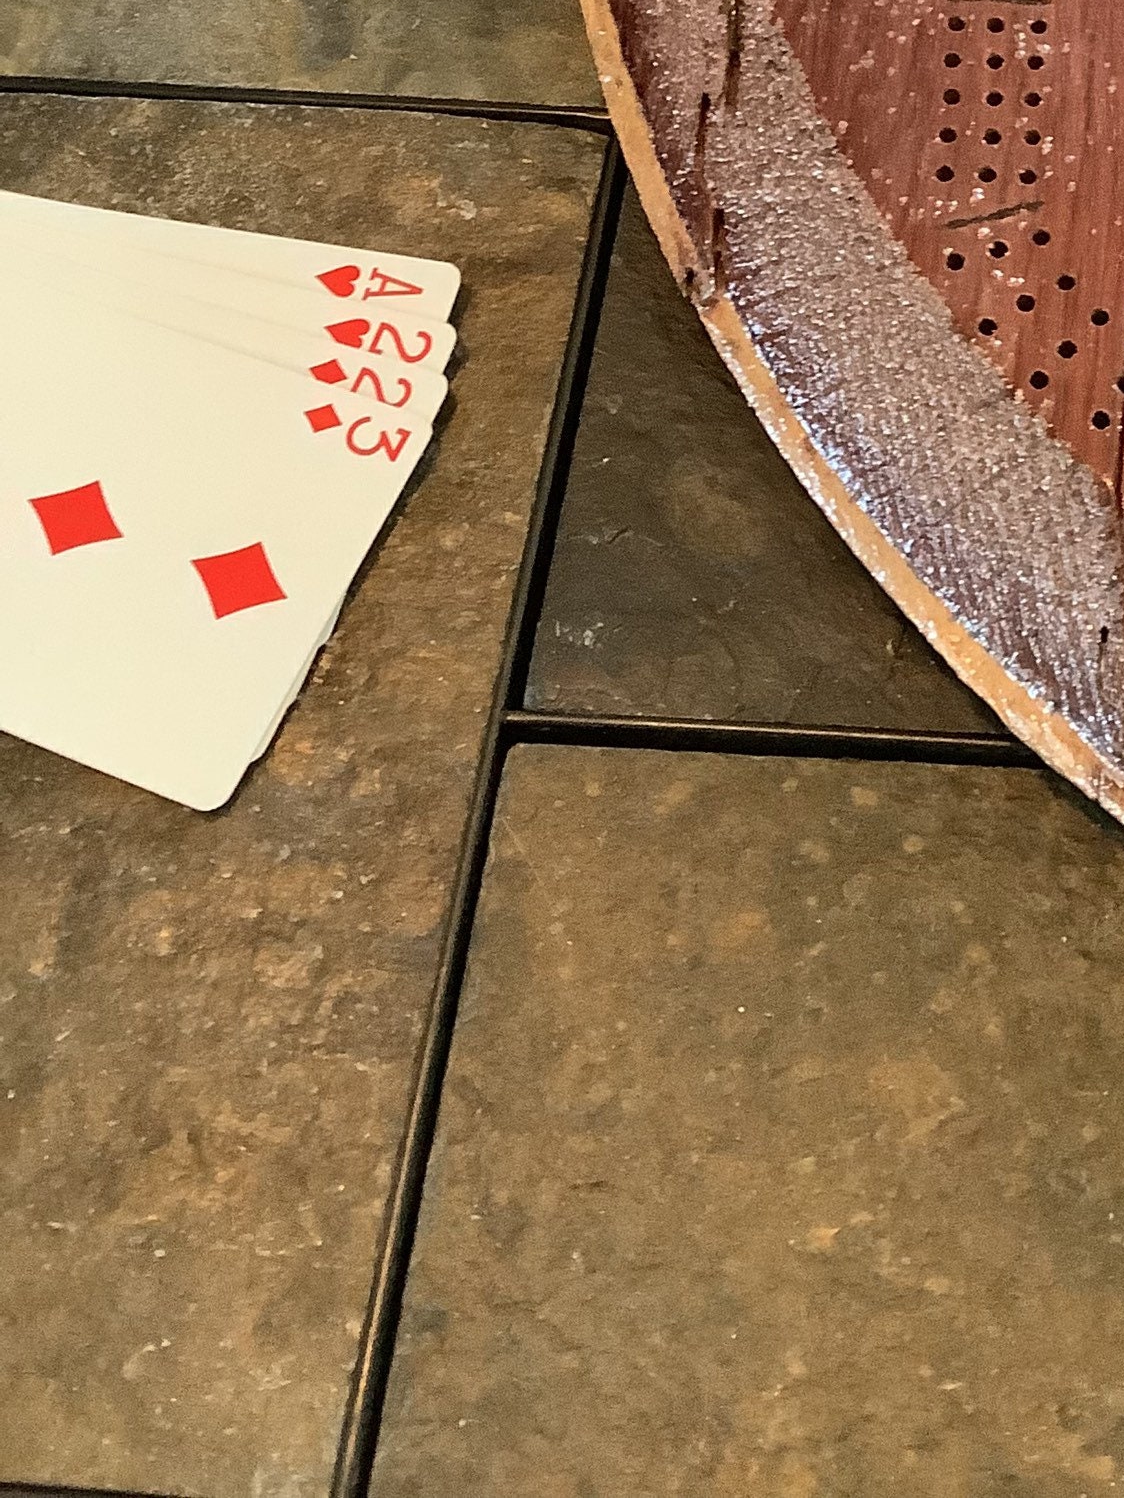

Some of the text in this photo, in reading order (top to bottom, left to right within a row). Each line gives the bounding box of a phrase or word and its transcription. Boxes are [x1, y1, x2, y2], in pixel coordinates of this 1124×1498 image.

[362, 267, 423, 301] A
[369, 322, 431, 362] 2
[351, 367, 412, 408] 2
[346, 416, 411, 461] 3
